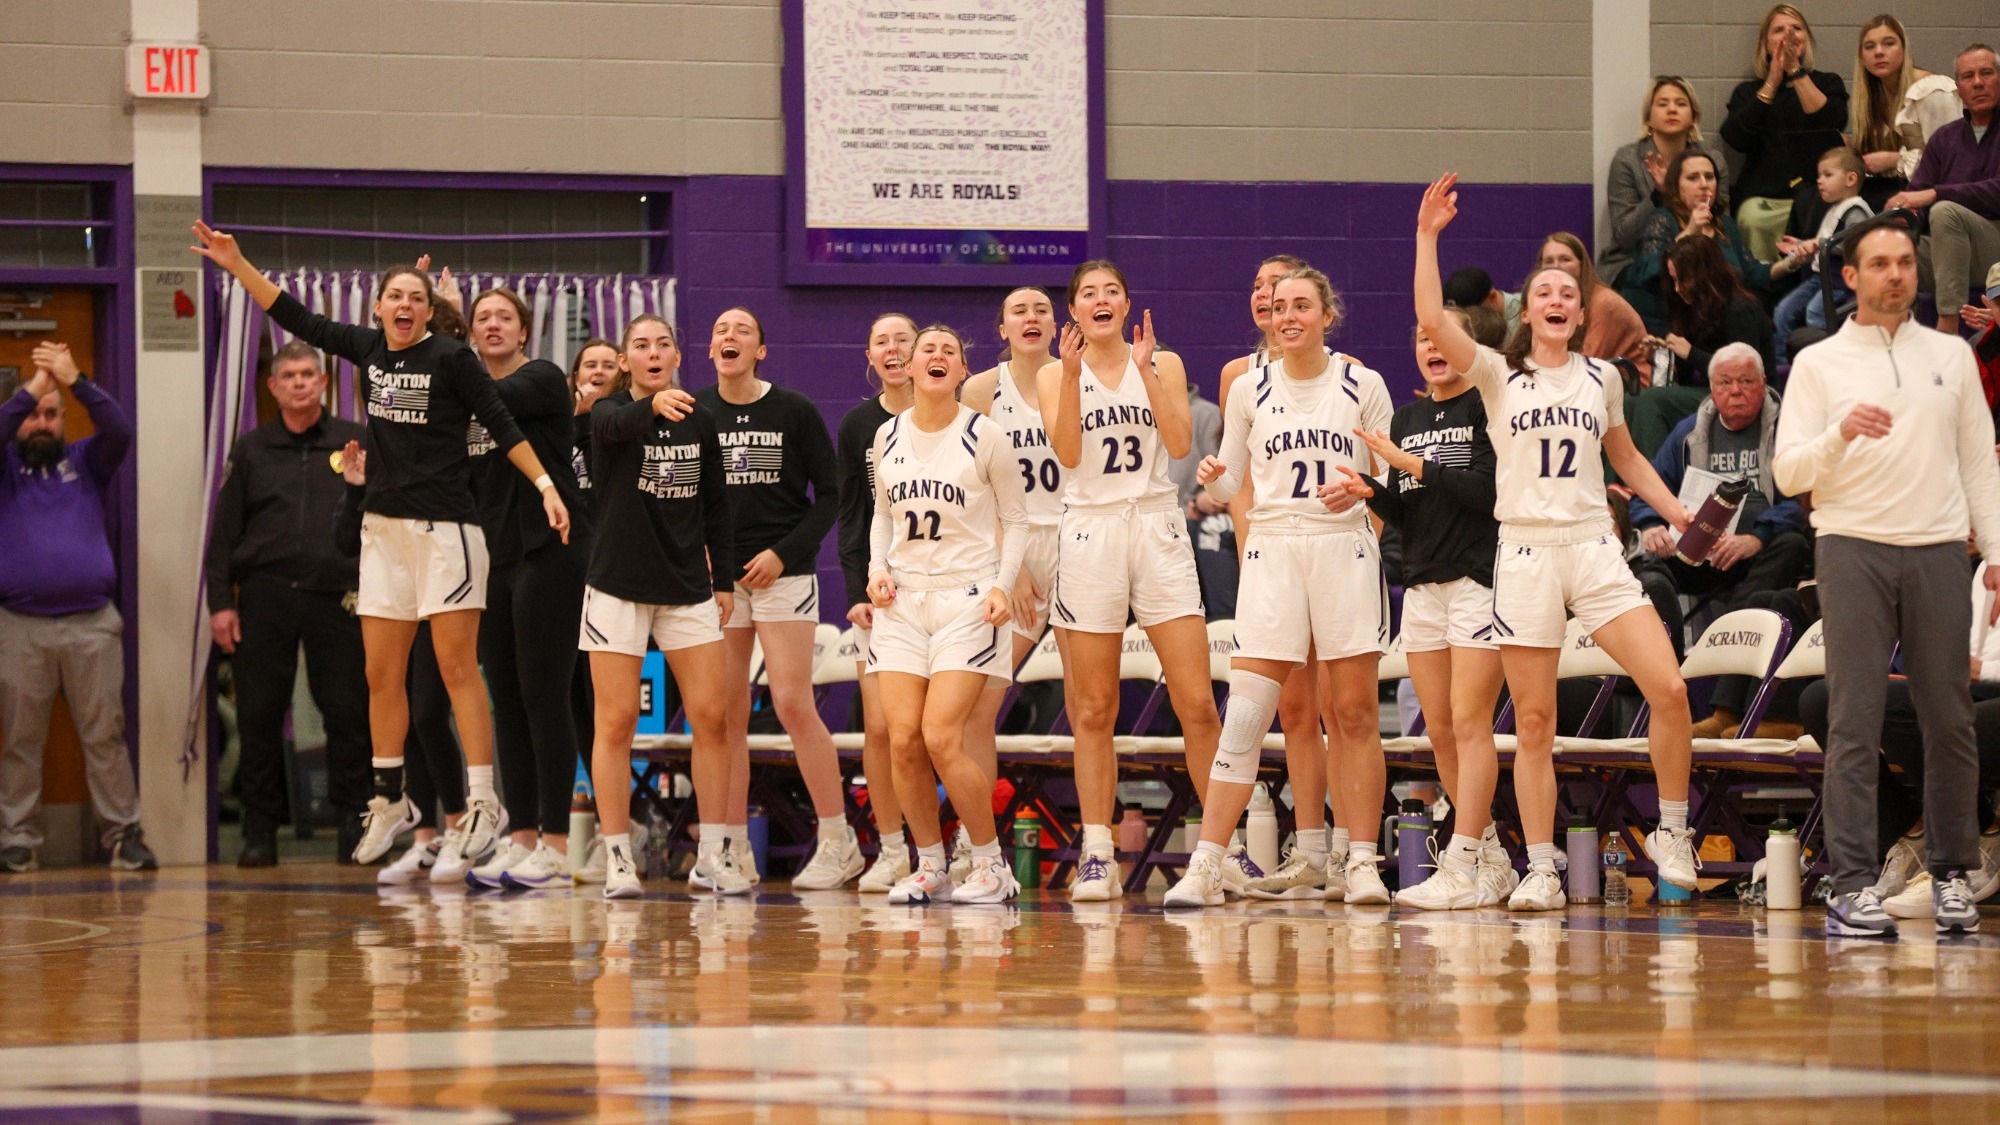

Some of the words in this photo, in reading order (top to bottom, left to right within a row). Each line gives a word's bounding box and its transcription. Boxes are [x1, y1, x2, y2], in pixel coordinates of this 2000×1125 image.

[880, 11, 898, 19] KEEP
[901, 11, 915, 19] THE
[958, 13, 976, 21] KEEP
[908, 51, 941, 59] MUTUAL
[979, 52, 1007, 60] TOUGH
[1009, 53, 1029, 61] LOVE
[145, 47, 199, 93] EXIT
[899, 64, 922, 72] TOTAL
[924, 65, 944, 73] CARE
[859, 89, 889, 97] HONOR
[949, 104, 962, 112] ALL
[964, 104, 979, 112] THE
[851, 127, 865, 135] ARE
[868, 127, 884, 135] ONE
[909, 128, 955, 136] RELENTLESS
[957, 129, 989, 137] PURSUIT
[1001, 130, 1047, 138] EXCELLENCE
[985, 143, 1000, 151] THE
[873, 183, 901, 198] WE
[910, 183, 943, 199] ARE
[826, 243, 853, 253] THE
[862, 243, 953, 254] UNIVERSITY
[960, 244, 980, 254] OF
[987, 245, 1070, 256] SCRANTON
[1081, 405, 1158, 434] CRANTO
[1511, 406, 1600, 440] SCRANTON
[718, 431, 783, 446] RANTON
[1265, 428, 1353, 460] SCRANTON
[643, 443, 700, 461] RANTON
[1102, 435, 1143, 475] 23
[1538, 438, 1578, 478] 12
[1710, 452, 1736, 471] PER
[1739, 450, 1758, 469] BO
[726, 470, 780, 485] KETBALL
[1018, 458, 1060, 493] 30
[1291, 460, 1326, 498] 21
[886, 479, 965, 509] SCRANTON
[905, 510, 942, 541] 22
[1705, 630, 1764, 648] SCRANTON
